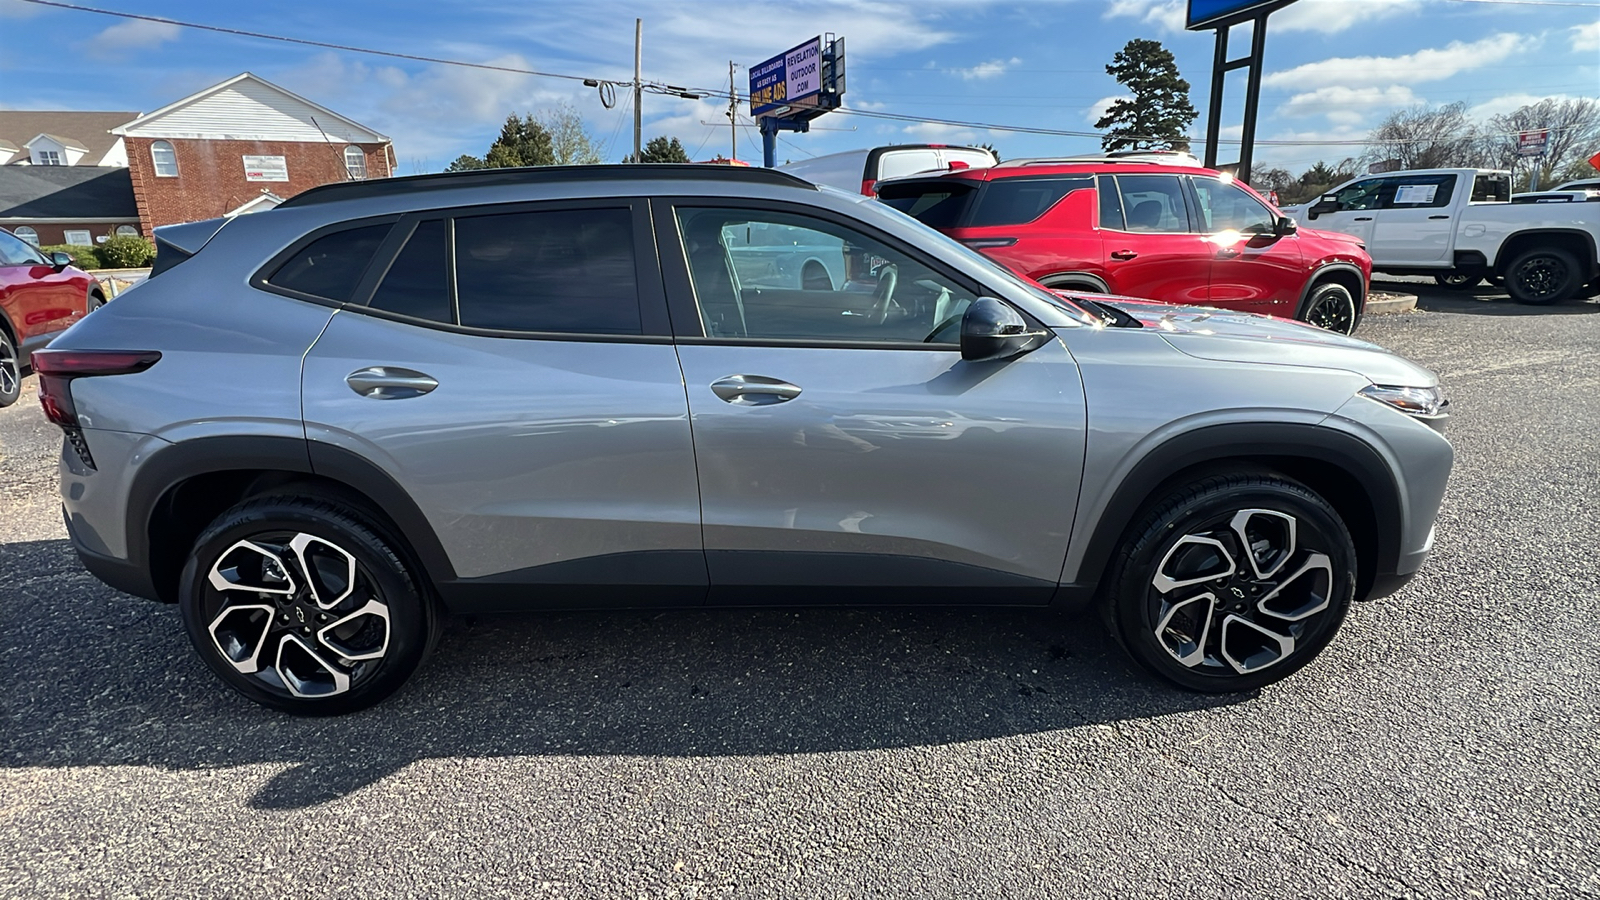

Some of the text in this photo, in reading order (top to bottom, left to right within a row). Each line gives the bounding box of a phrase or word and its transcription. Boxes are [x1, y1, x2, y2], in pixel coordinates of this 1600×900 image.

[787, 45, 818, 67] REVELATION
[751, 59, 783, 80] LOCAL BILLBOARDS
[790, 63, 816, 81] OUTDOOR
[751, 81, 785, 109] ONLINE ADS
[795, 81, 808, 93] .COM
